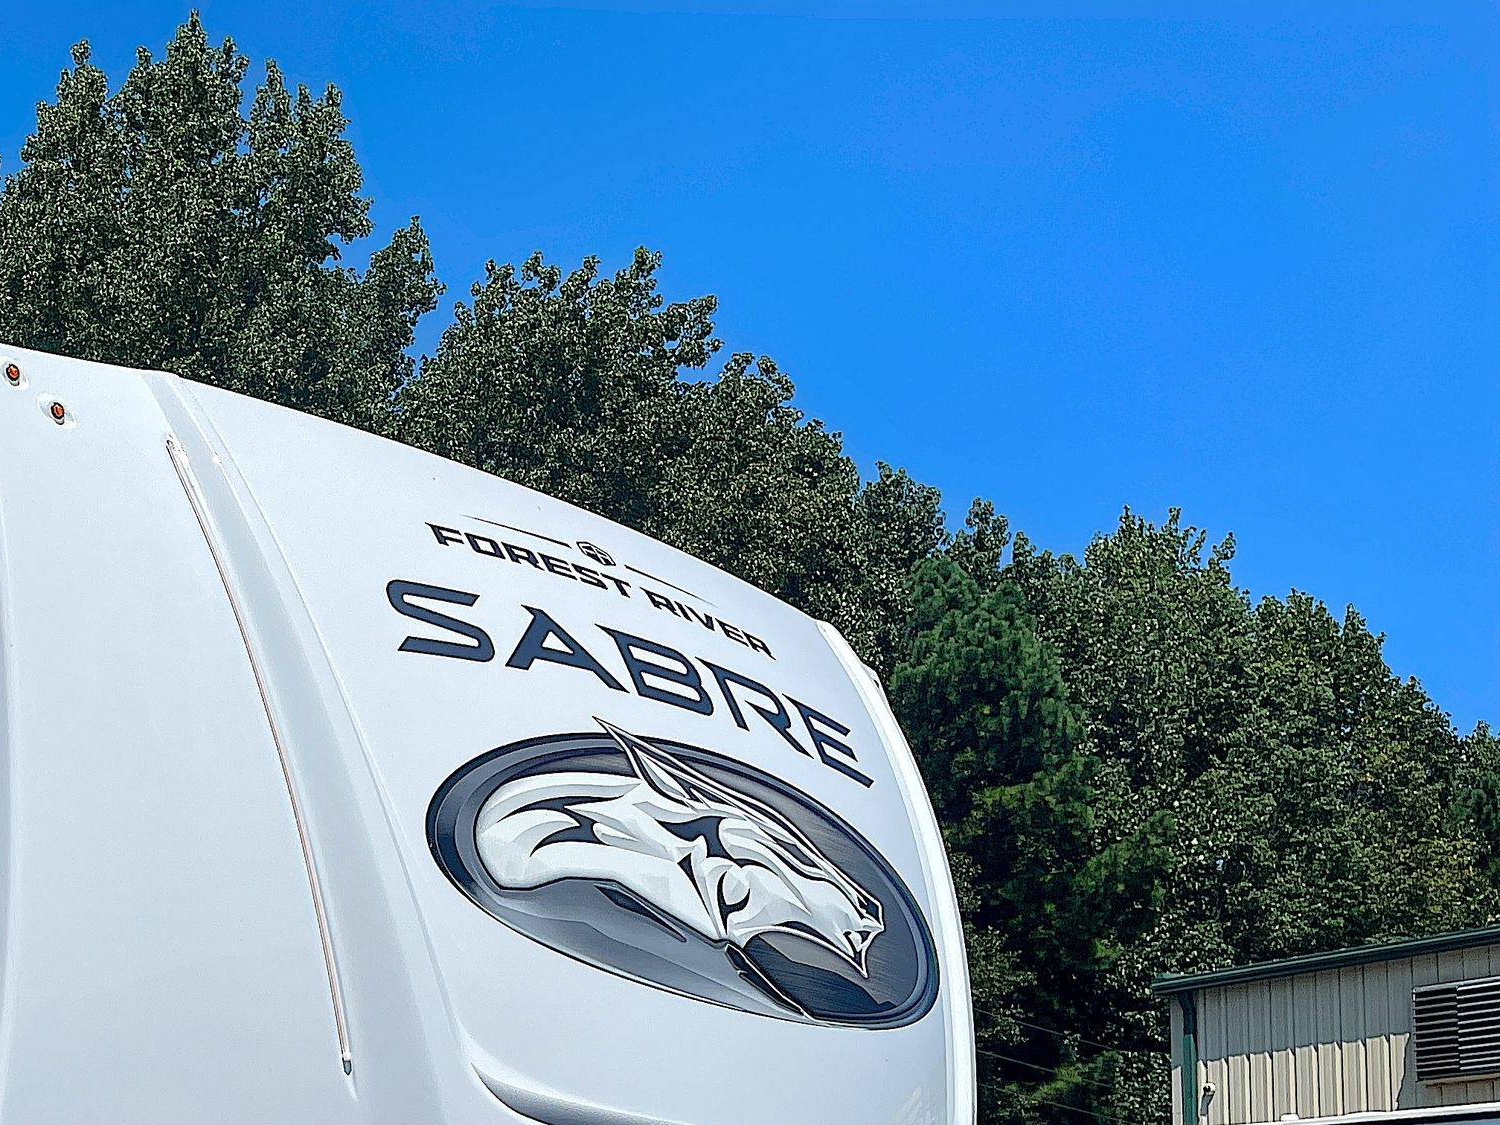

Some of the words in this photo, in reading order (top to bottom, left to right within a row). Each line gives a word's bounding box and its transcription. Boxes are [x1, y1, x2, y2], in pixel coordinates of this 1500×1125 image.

[425, 522, 632, 600] FOREST
[639, 586, 777, 660] RIVER
[386, 579, 875, 789] SABRE
